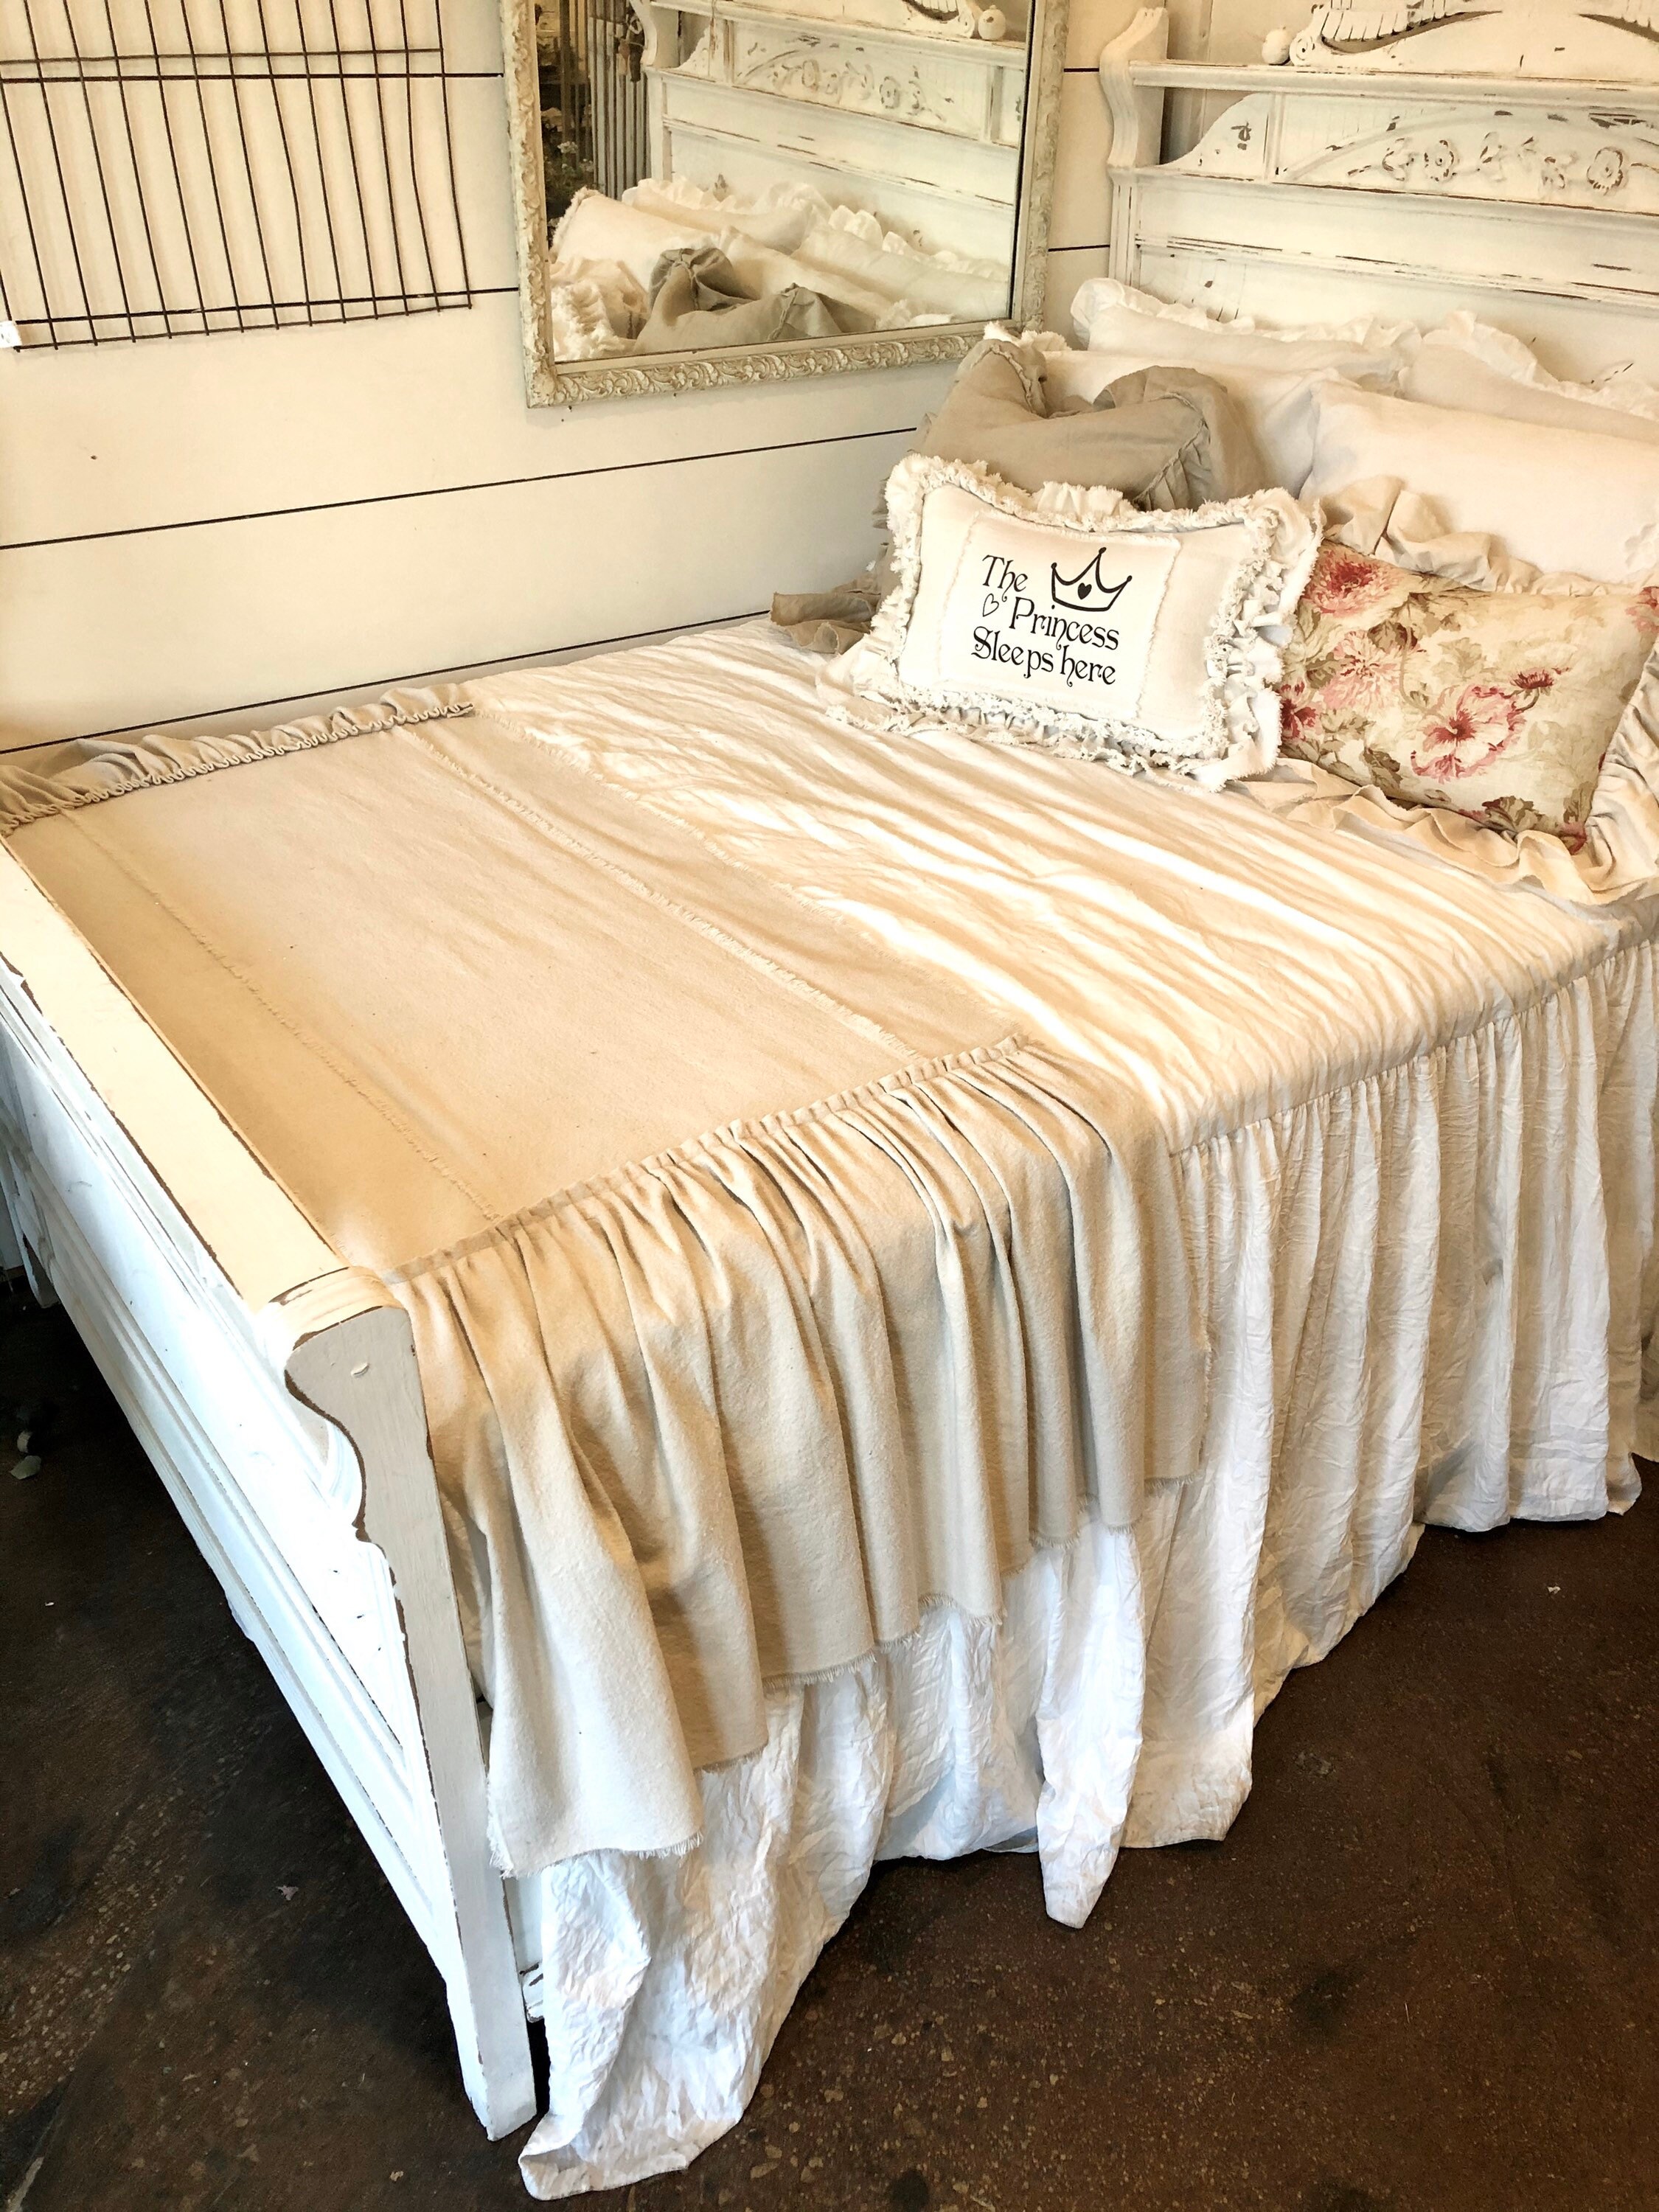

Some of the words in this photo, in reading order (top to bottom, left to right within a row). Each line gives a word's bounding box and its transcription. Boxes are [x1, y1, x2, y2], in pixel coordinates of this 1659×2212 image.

[982, 554, 1028, 602] The
[1009, 597, 1119, 650] Princess
[971, 626, 1054, 678] Sleeps
[1060, 644, 1116, 687] here
